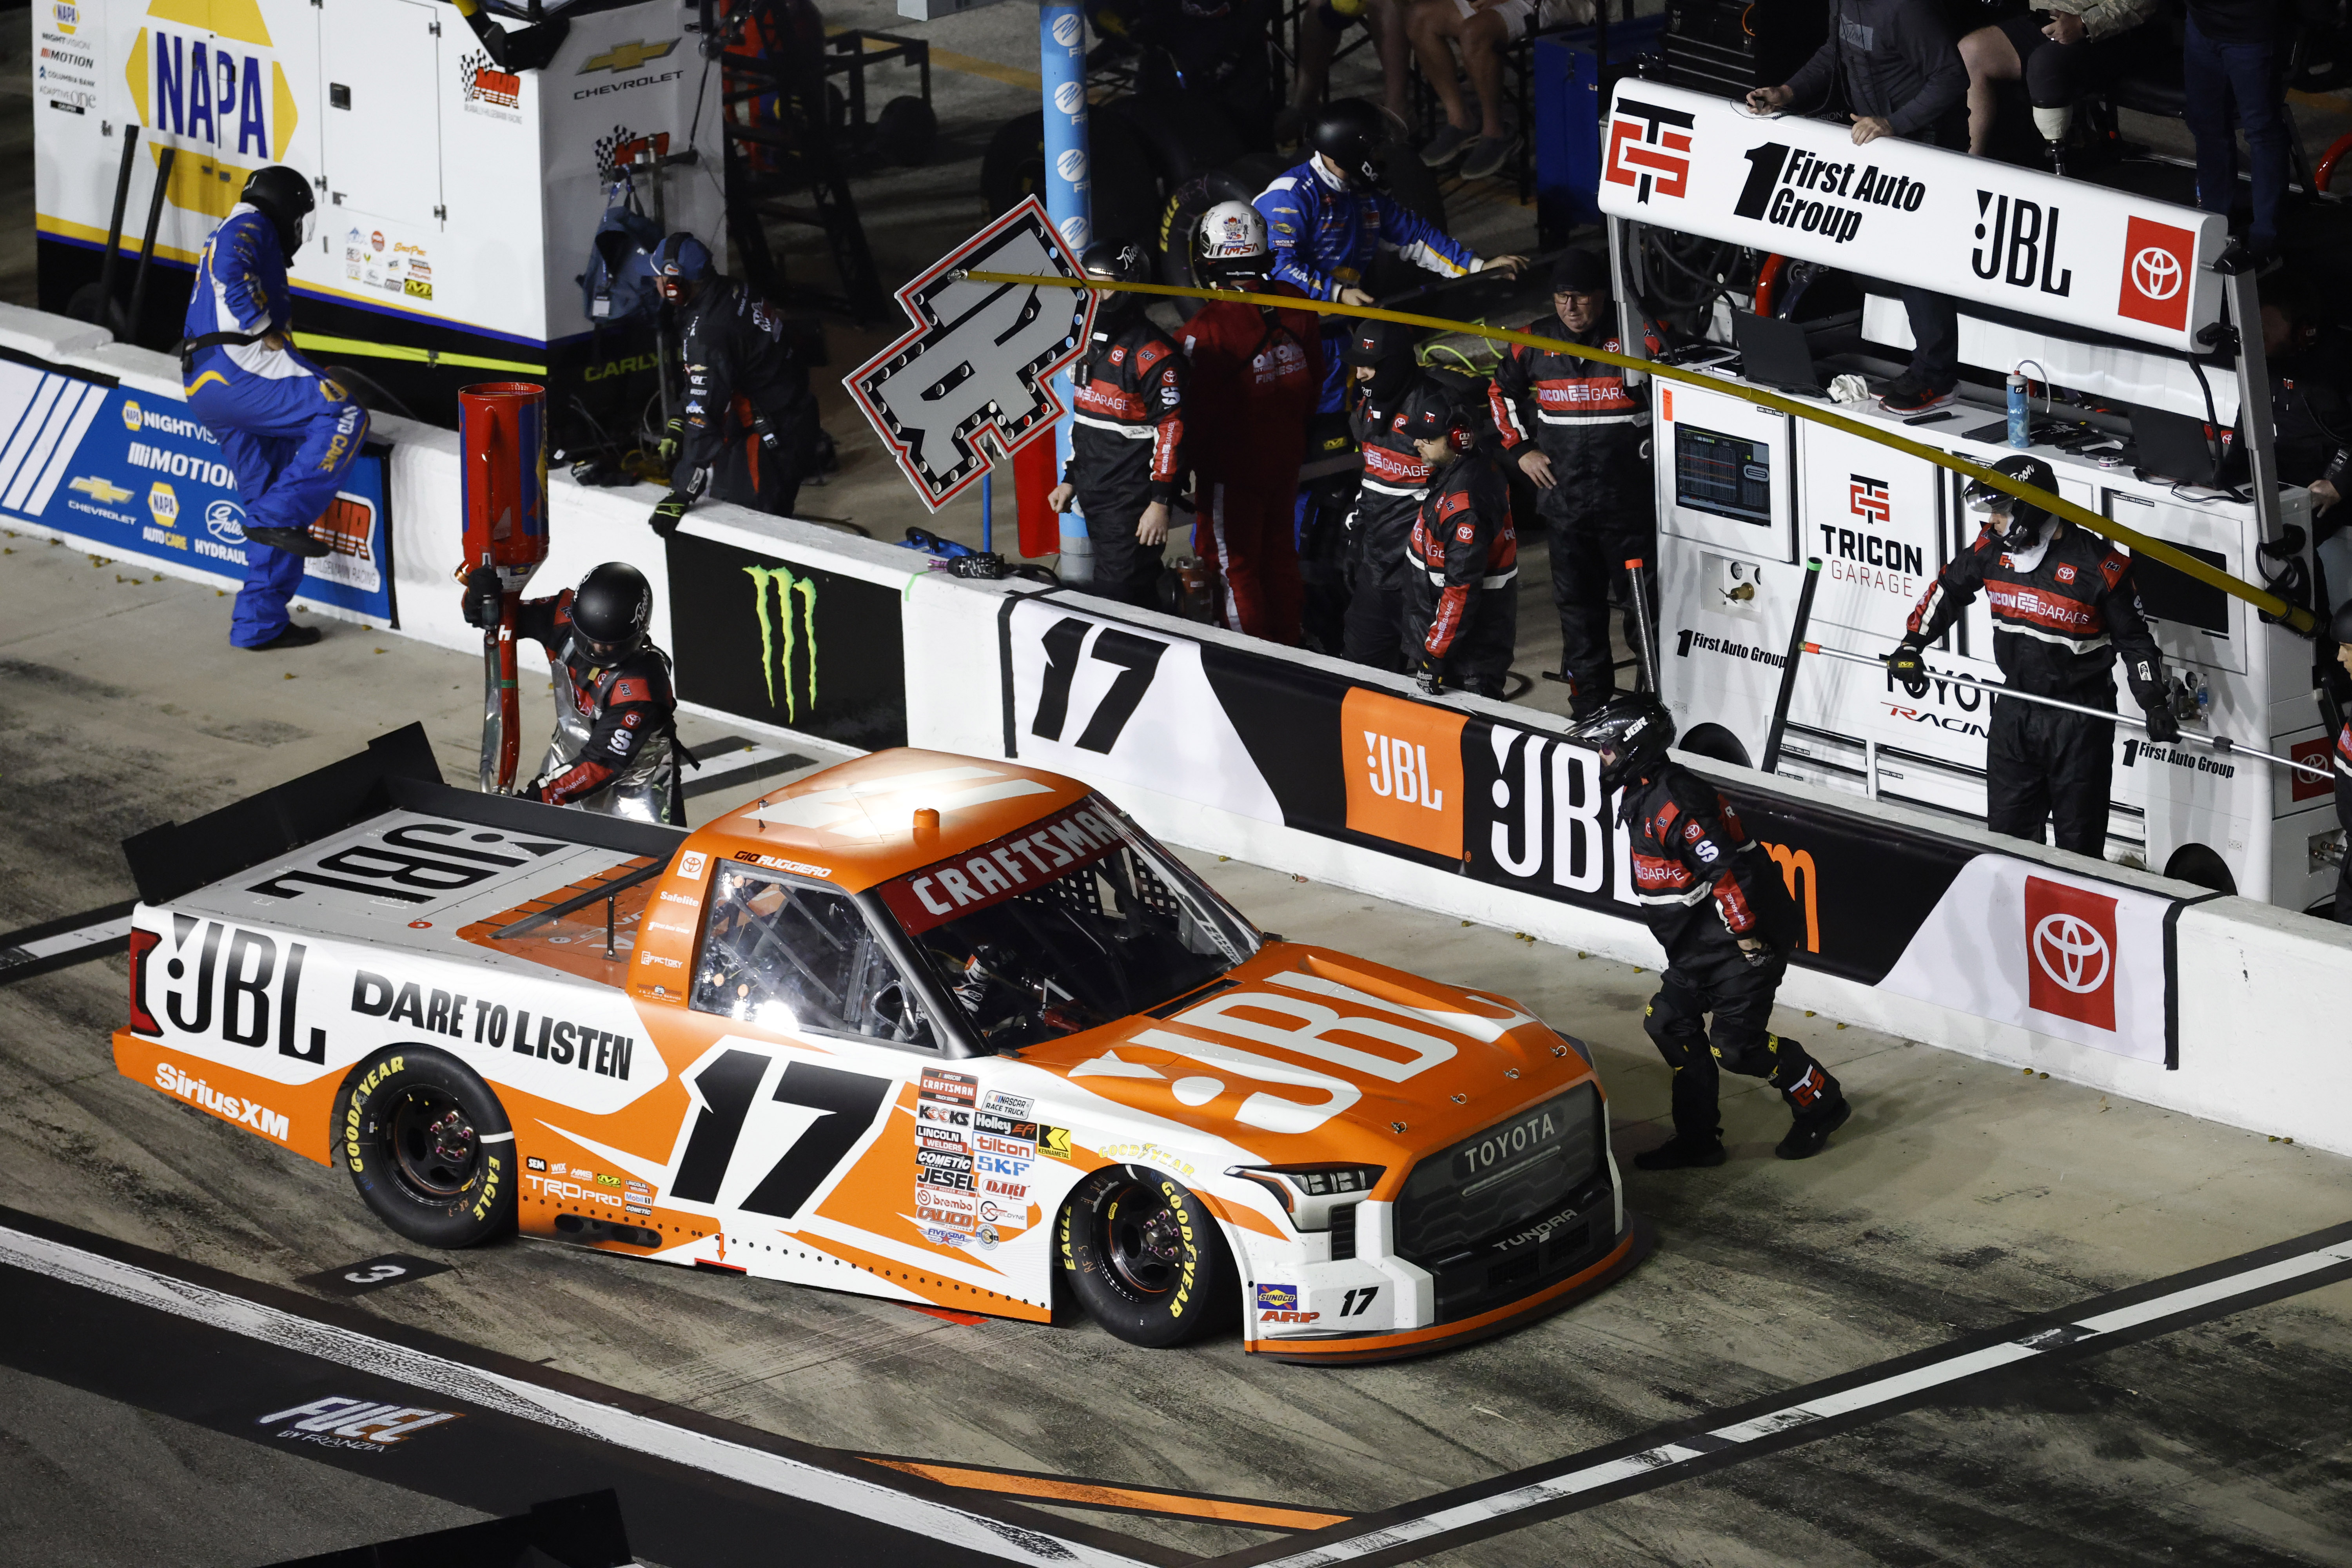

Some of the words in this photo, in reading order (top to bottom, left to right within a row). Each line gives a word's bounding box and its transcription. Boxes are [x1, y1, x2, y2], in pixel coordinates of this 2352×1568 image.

[157, 31, 268, 159] NAPA
[573, 70, 684, 101] CHEVROLET
[1733, 142, 1790, 221] 1
[1782, 148, 1855, 199] First
[1852, 165, 1926, 212] Auto
[1769, 188, 1863, 244] Group
[1972, 190, 2071, 298] JBL
[1089, 392, 1129, 411] GARAGE
[1538, 388, 1568, 401] RICON
[1591, 387, 1629, 401] GARA
[126, 408, 140, 423] NAPA
[143, 410, 220, 445] NIGHTVIS
[1383, 457, 1430, 477] GARAGE
[68, 500, 136, 526] CHEVROLET
[153, 496, 175, 515] NAPA
[207, 506, 245, 536] Gate
[143, 526, 165, 544] AUTO
[165, 532, 187, 550] CARE
[1820, 524, 1922, 576] TRICON
[194, 539, 249, 566] HYDRAUL
[1832, 560, 1913, 597] GARAGE
[1988, 591, 2016, 608] RICON
[2038, 602, 2090, 624] GARAGE
[1677, 629, 1693, 657] 1
[1693, 632, 1720, 653] First
[1721, 639, 1748, 659] Auto
[1751, 647, 1787, 669] Group
[1031, 617, 1171, 755] 17
[1878, 653, 2002, 717] TOYOT
[1623, 716, 1648, 742] JGR
[1891, 708, 1989, 739] RACIN
[1364, 731, 1442, 811] JBL
[2123, 739, 2139, 767] 1
[2139, 742, 2165, 761] First
[2168, 749, 2196, 768] Auto
[2198, 757, 2235, 779] Group
[565, 775, 588, 793] GARAGE
[245, 824, 569, 905] JBL
[734, 851, 760, 862] GIO
[756, 855, 832, 877] RUGGIERO
[660, 891, 699, 906] Safelite
[650, 955, 683, 968] FACTORY
[165, 913, 325, 1065] JBL
[351, 970, 467, 1036] DARE
[474, 1000, 508, 1048] TO
[512, 1011, 633, 1081] LISTEN
[1068, 971, 1536, 1134] JBL
[923, 1079, 974, 1096] CRAFTSMAN
[155, 1063, 289, 1141] SiriusXM
[346, 1056, 404, 1172] GOODYEAR
[1000, 1096, 1026, 1108] NASCAR
[1005, 1107, 1024, 1116] TRUCK
[919, 1104, 970, 1127] KOOKS
[976, 1113, 1011, 1134] Holley
[669, 1049, 892, 1220] 17
[918, 1127, 959, 1142] LINCOLN
[927, 1139, 963, 1152] WELDERS
[977, 1136, 1030, 1157] tilton
[1465, 1113, 1555, 1173] TOYOTA
[528, 1158, 544, 1170] SEM
[918, 1151, 971, 1170] COMETIC
[977, 1156, 1029, 1176] SKF
[1038, 1148, 1069, 1159] KENNAMETAL
[1098, 1142, 1194, 1177] GOODYEAR
[551, 1163, 566, 1171] WIX
[571, 1168, 593, 1178] HMS
[918, 1167, 976, 1191] JESEL
[473, 1156, 500, 1221] EAGLE
[526, 1174, 581, 1200] TRD
[583, 1190, 622, 1207] PRO
[626, 1194, 643, 1202] Mobil
[986, 1180, 1030, 1198] DART
[626, 1205, 651, 1215] COMETIC
[933, 1195, 973, 1211] brembo
[917, 1207, 973, 1228] CALICO
[1492, 1209, 1578, 1251] TUNDRA
[947, 1232, 965, 1241] STAR
[1060, 1203, 1076, 1270] EAGLE
[1161, 1181, 1197, 1318] GOODYEAR
[1340, 1287, 1379, 1317] 17
[1260, 1310, 1320, 1323] ARP
[259, 1397, 456, 1443] FUEL
[277, 1430, 304, 1439] BY
[307, 1434, 386, 1453] FRANZIA
